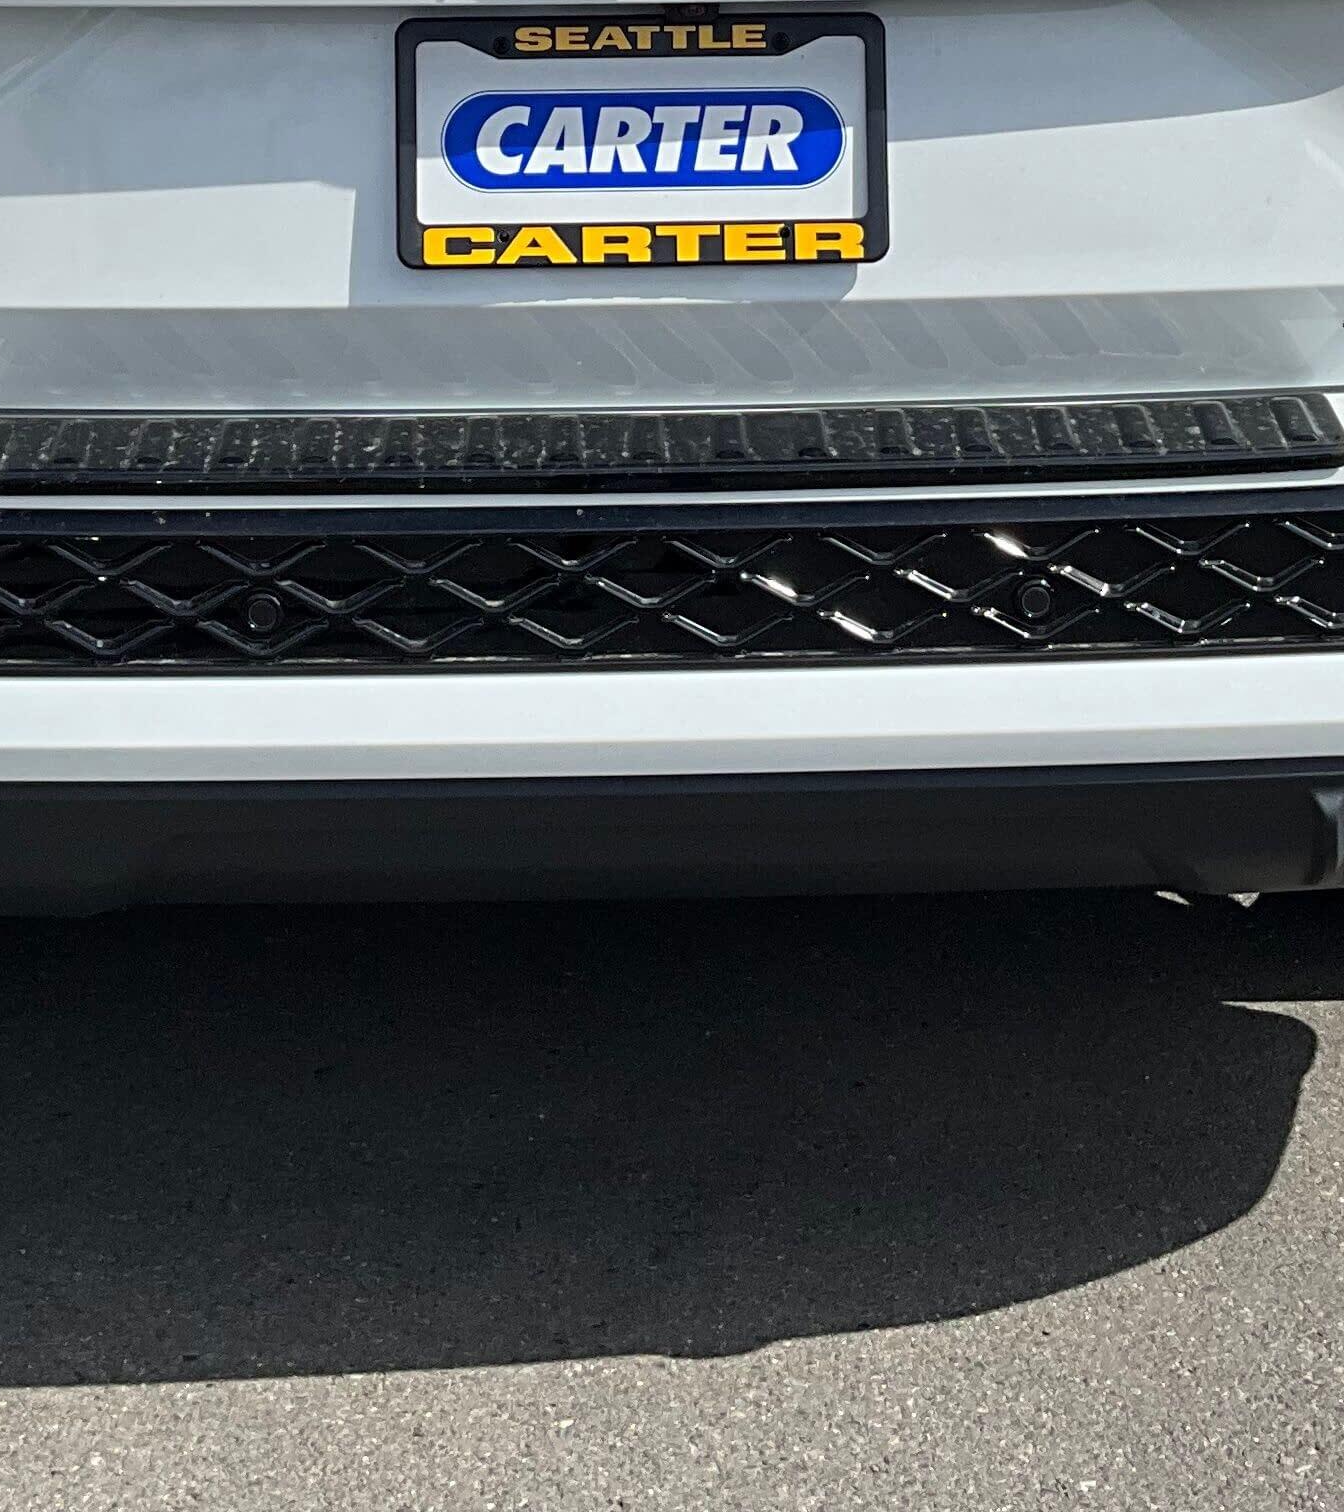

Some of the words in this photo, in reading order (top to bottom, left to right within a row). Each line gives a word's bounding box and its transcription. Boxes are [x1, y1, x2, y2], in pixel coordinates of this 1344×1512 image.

[514, 24, 767, 52] SEATTLE
[475, 105, 805, 176] CARTER
[423, 223, 865, 266] CARTER
